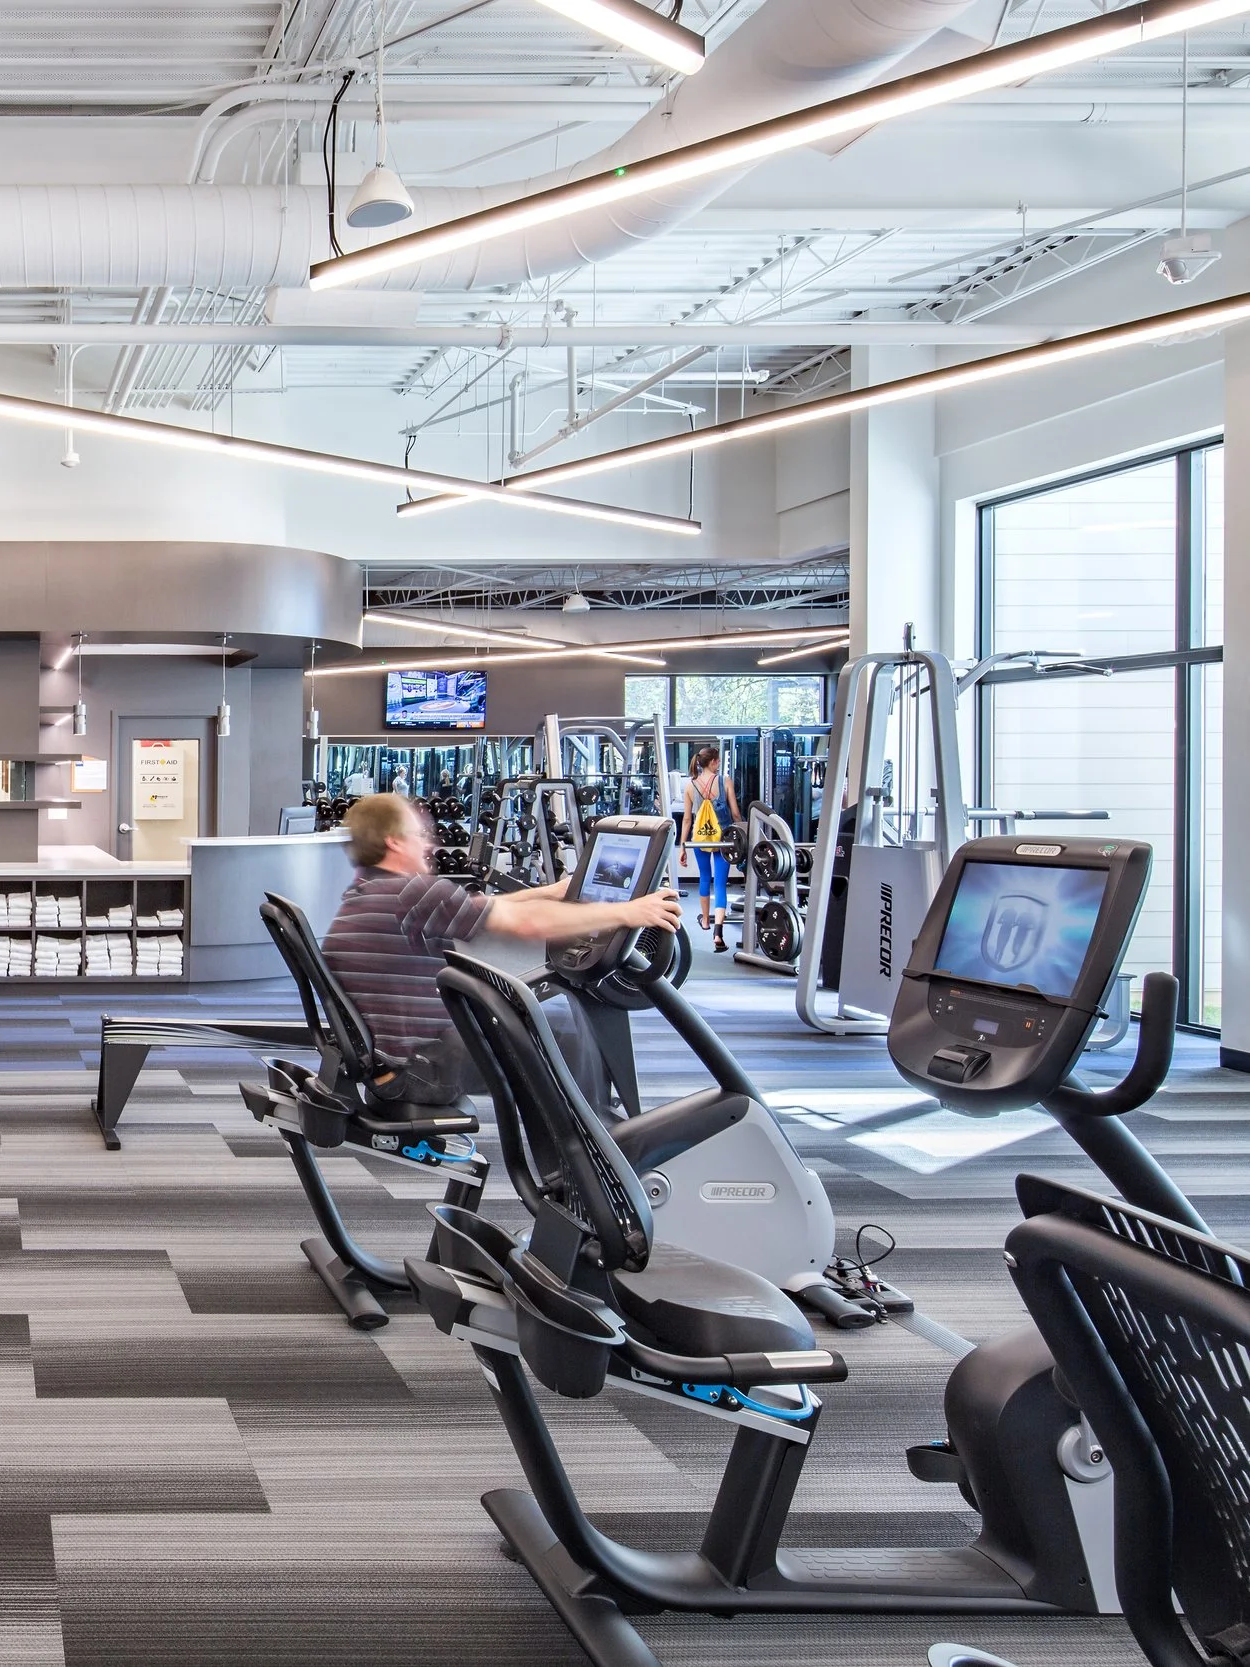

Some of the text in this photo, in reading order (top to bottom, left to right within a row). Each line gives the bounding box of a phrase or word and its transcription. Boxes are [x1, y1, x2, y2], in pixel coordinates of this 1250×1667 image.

[879, 893, 893, 978] PRECOR
[539, 981, 551, 993] 2
[717, 1187, 766, 1197] PRECOR
